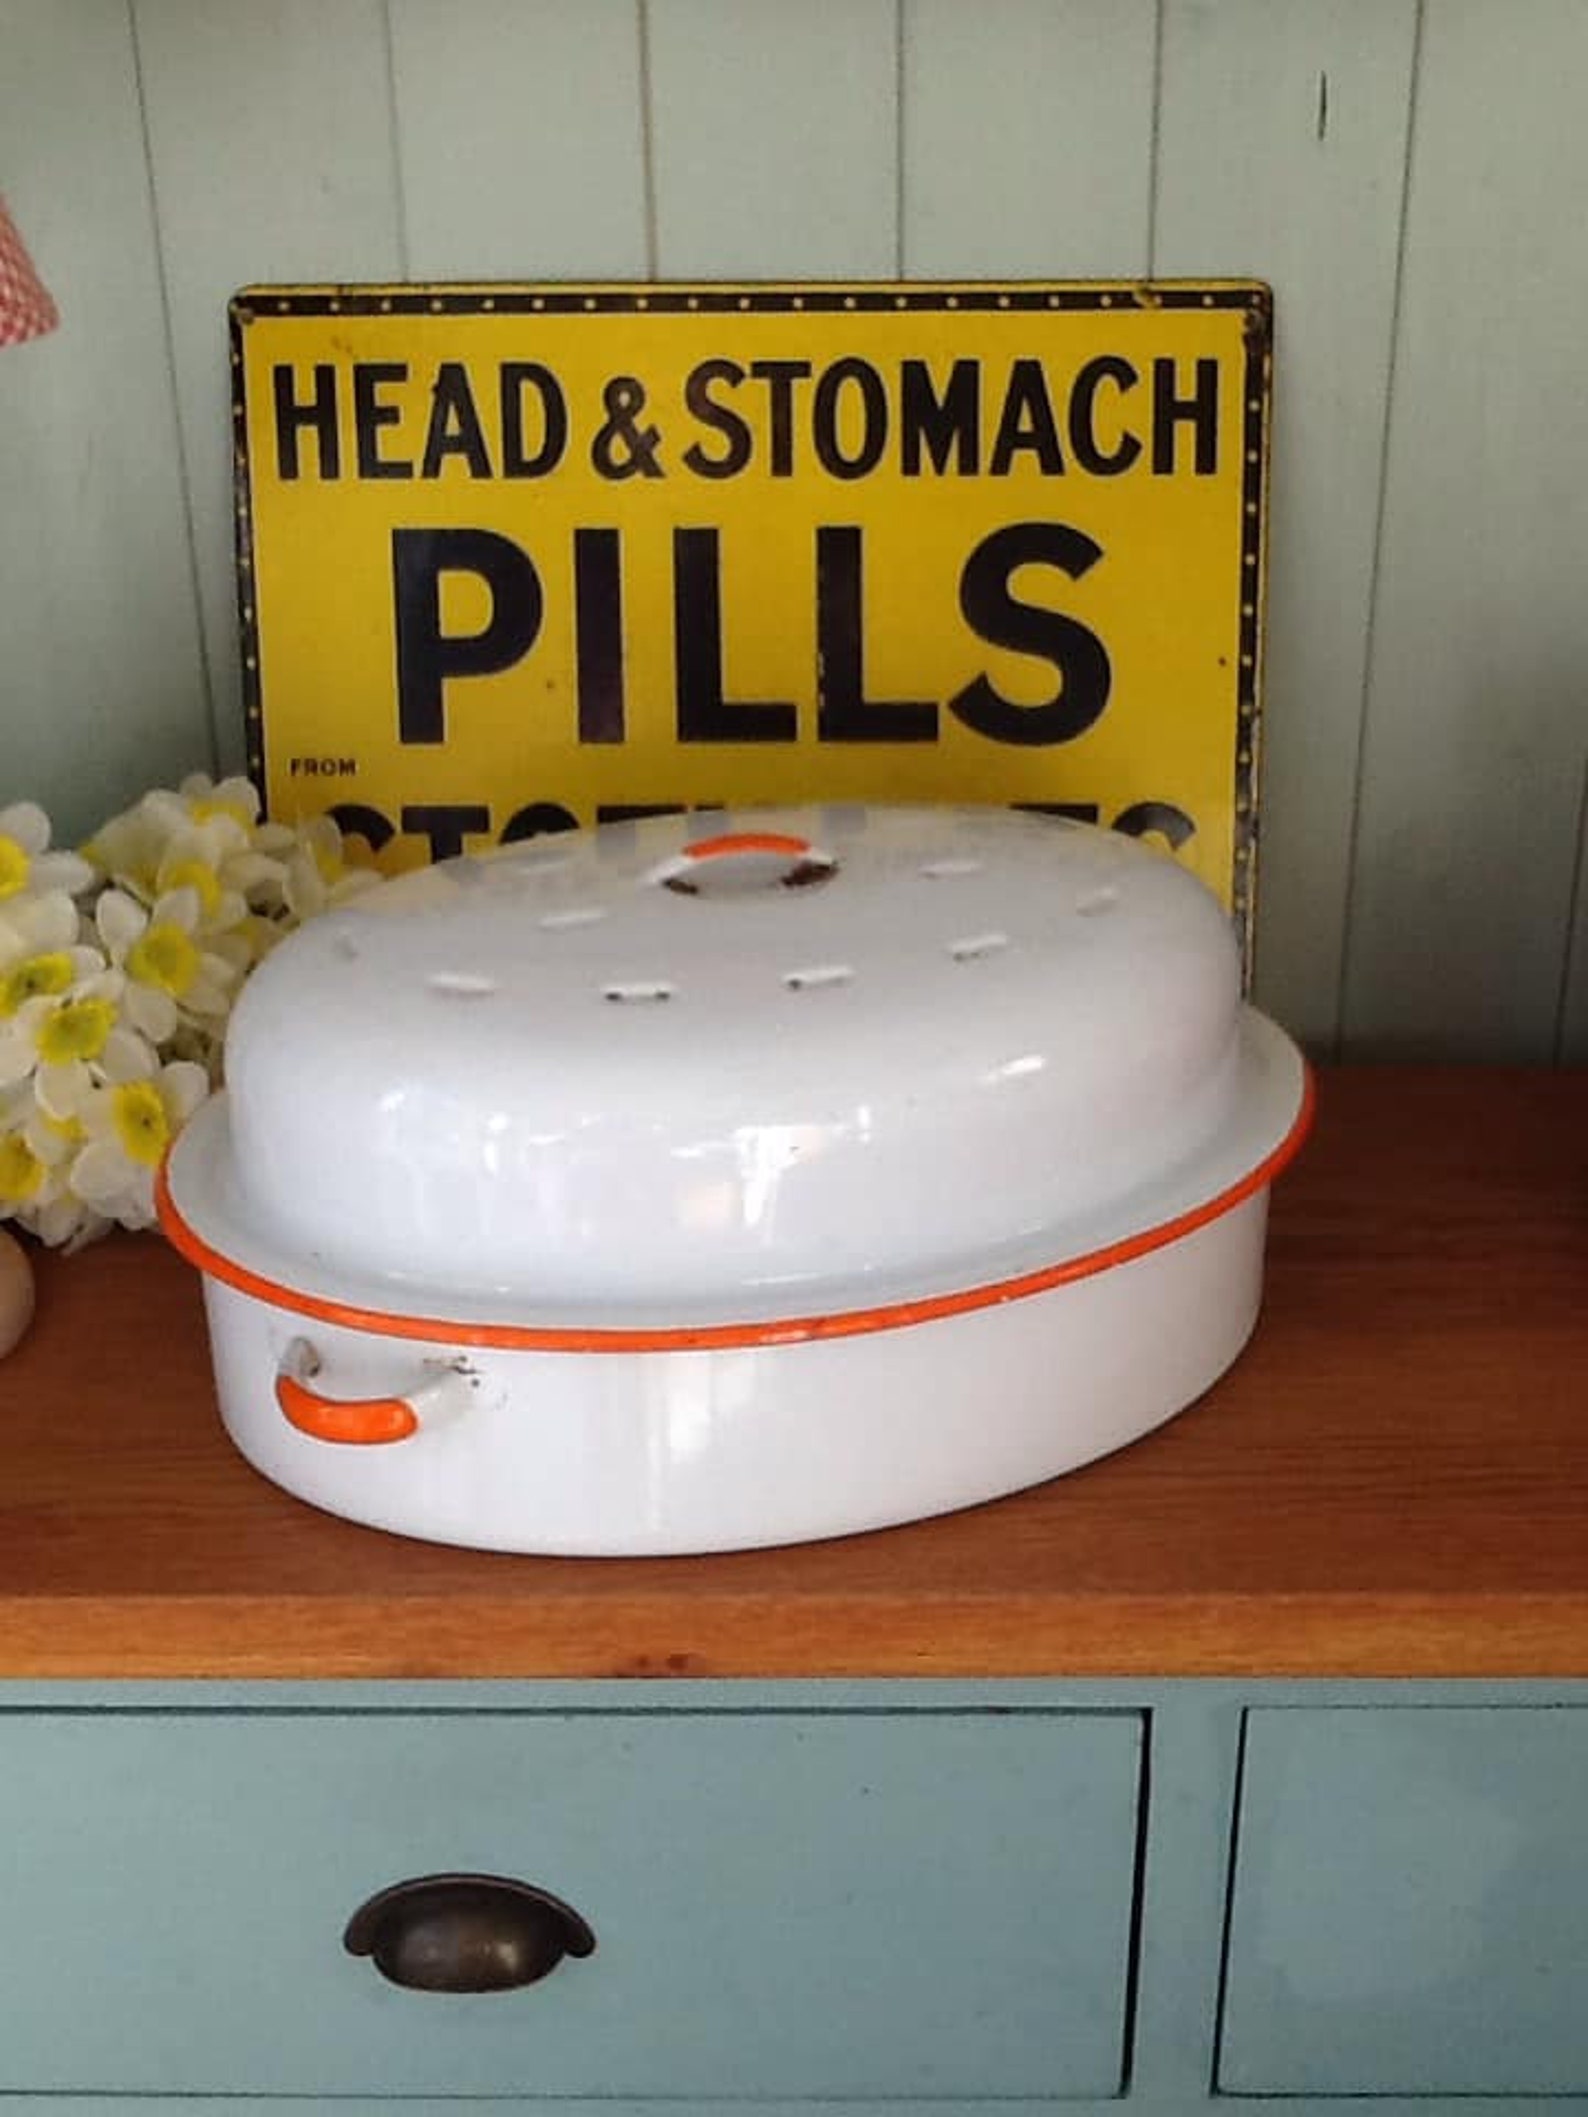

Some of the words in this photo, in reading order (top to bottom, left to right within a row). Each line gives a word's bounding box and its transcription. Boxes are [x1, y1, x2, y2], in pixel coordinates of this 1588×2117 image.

[272, 361, 568, 481] HEAD
[591, 373, 666, 481] &
[682, 355, 1220, 479] STOMACH
[391, 521, 1112, 747] PILLS
[289, 757, 357, 777] FROM
